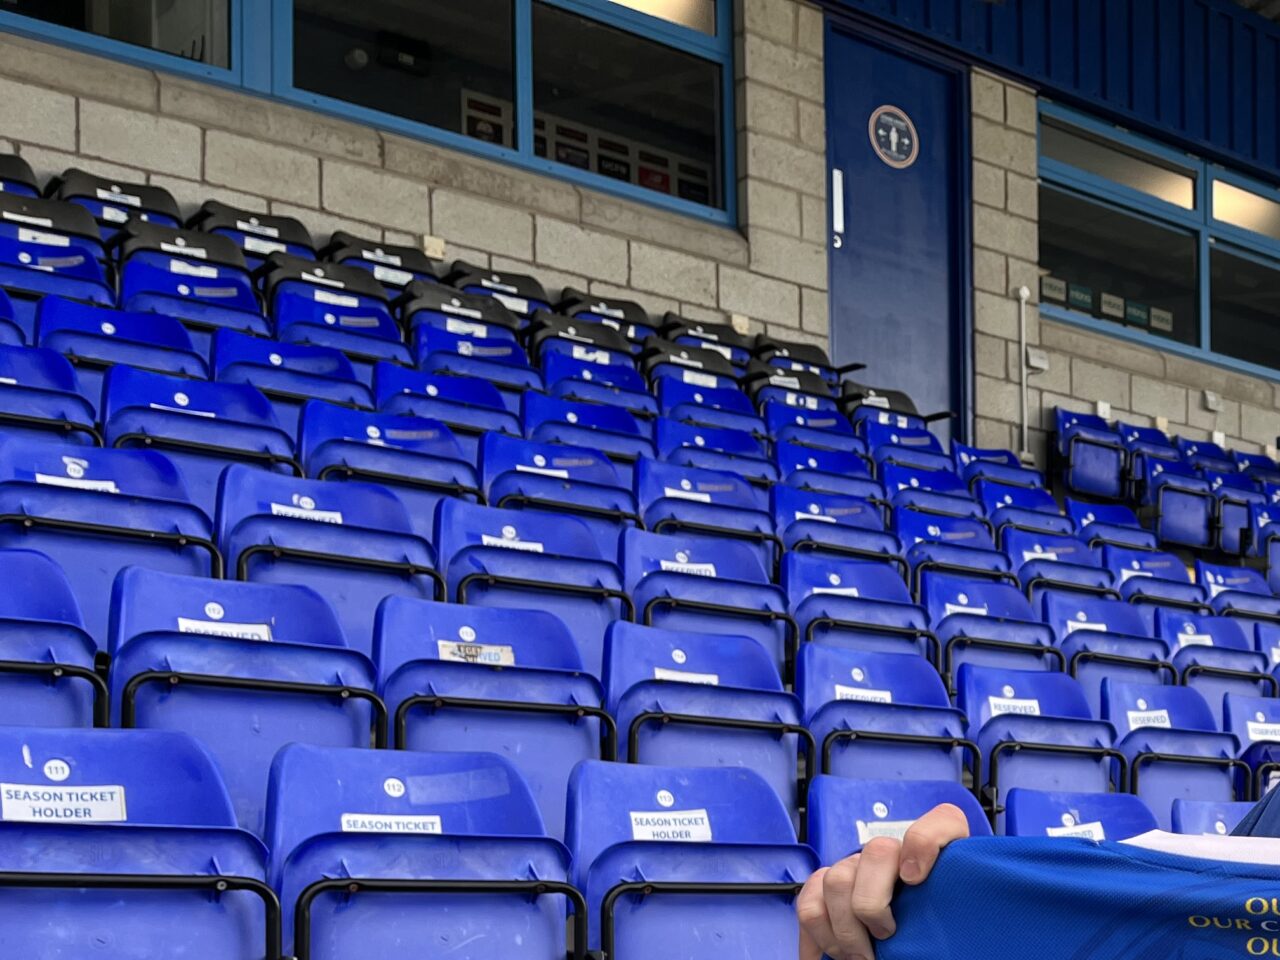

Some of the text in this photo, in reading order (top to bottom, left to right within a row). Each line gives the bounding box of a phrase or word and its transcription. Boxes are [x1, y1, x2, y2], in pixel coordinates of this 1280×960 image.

[993, 703, 1036, 713] RESERVED
[1131, 715, 1168, 725] RESERVED
[47, 766, 66, 775] 111
[386, 783, 403, 793] 112
[4, 789, 117, 802] SEASON TICKET
[32, 807, 92, 818] HOLDER
[346, 819, 437, 831] SEASON TICKET
[634, 817, 706, 826] SEASON TICKET
[652, 830, 692, 839] HOLDER
[1188, 915, 1252, 930] OUR
